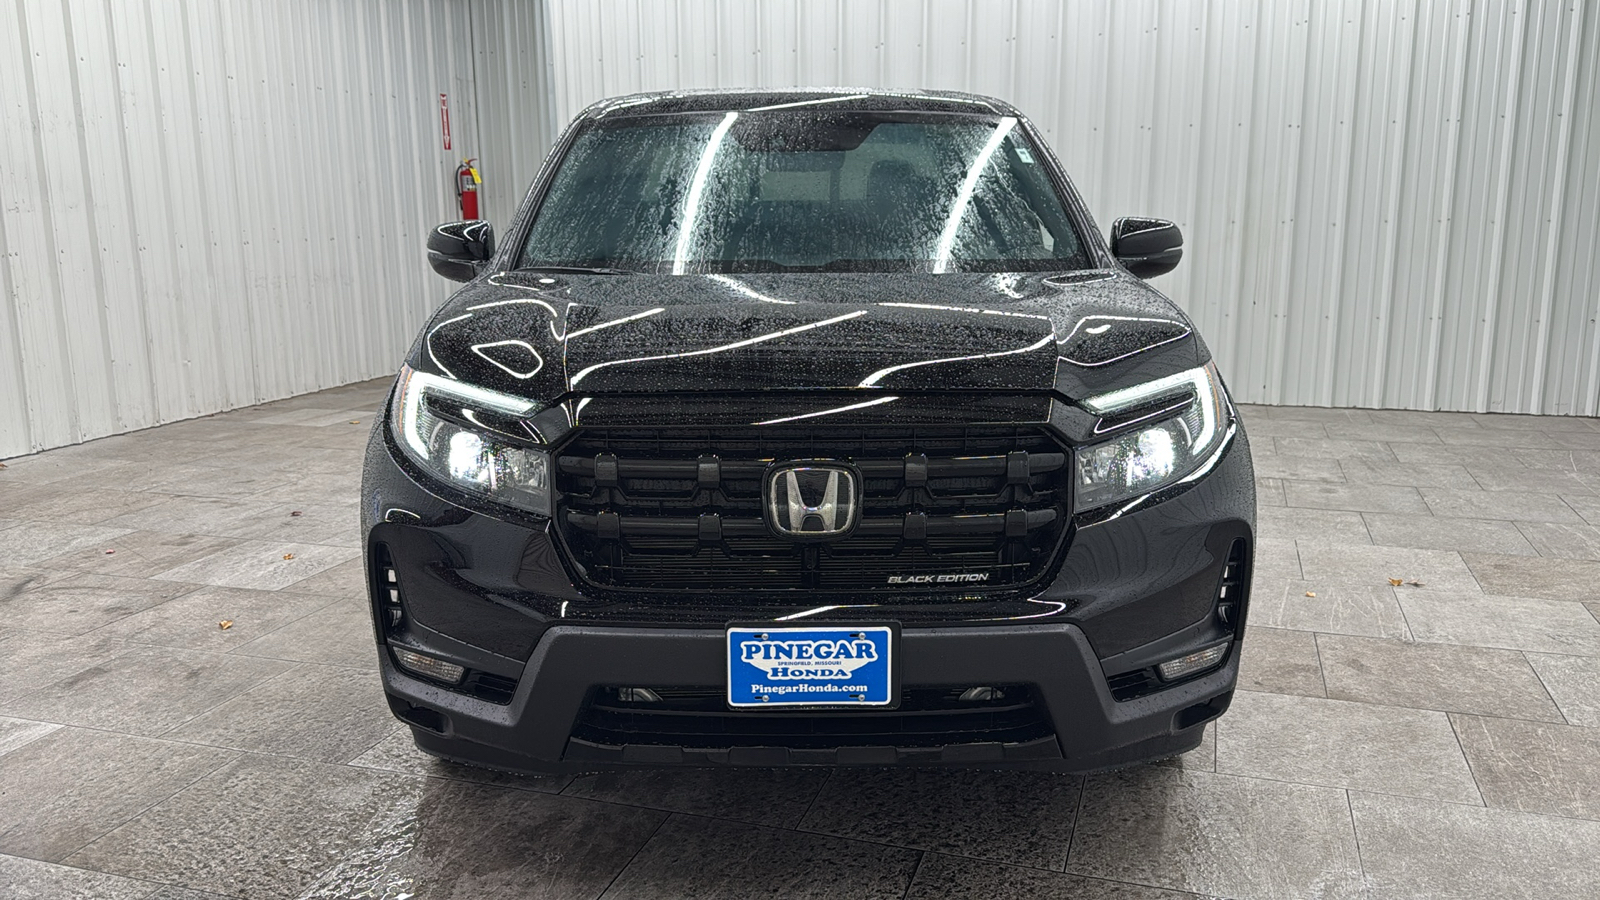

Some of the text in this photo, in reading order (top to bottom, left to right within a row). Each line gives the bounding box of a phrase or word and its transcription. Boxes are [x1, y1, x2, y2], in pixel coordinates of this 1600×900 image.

[887, 573, 989, 584] BLACK EDITION
[743, 642, 875, 660] PINEGAR
[770, 667, 849, 678] HONDA
[751, 683, 868, 695] PinegarHonda.com
